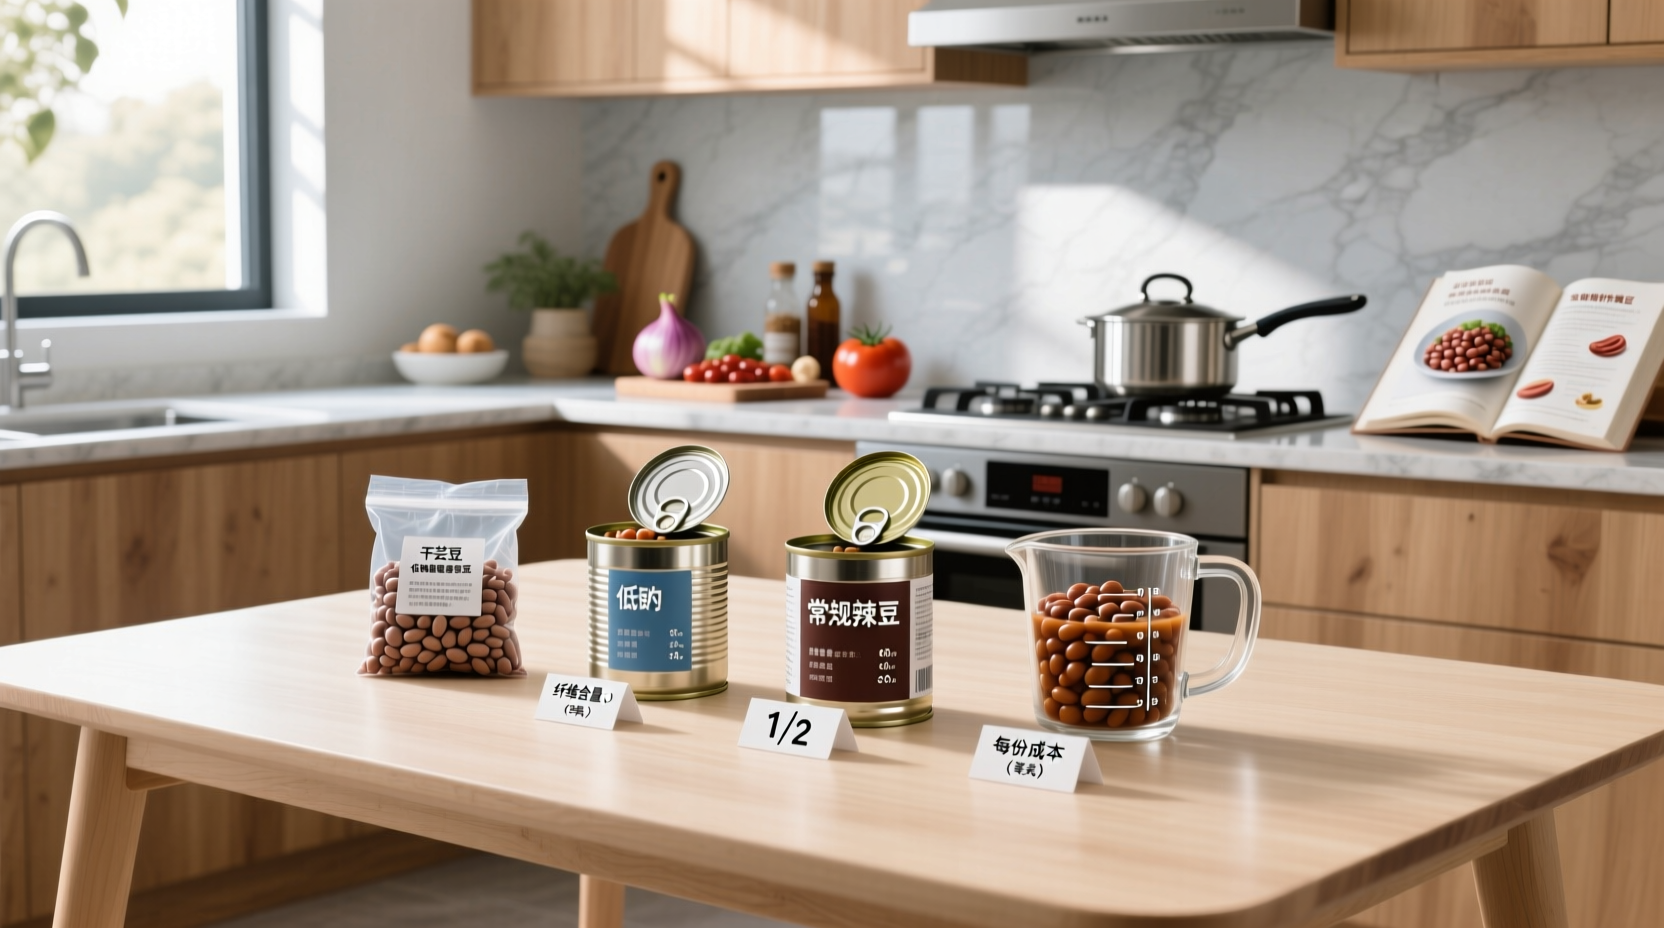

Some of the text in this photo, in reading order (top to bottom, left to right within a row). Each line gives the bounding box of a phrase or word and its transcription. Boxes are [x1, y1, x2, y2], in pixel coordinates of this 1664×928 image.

[808, 598, 900, 628] 常规辣豆
[768, 711, 812, 746] 1/2
[993, 735, 1065, 761] 每份成本
